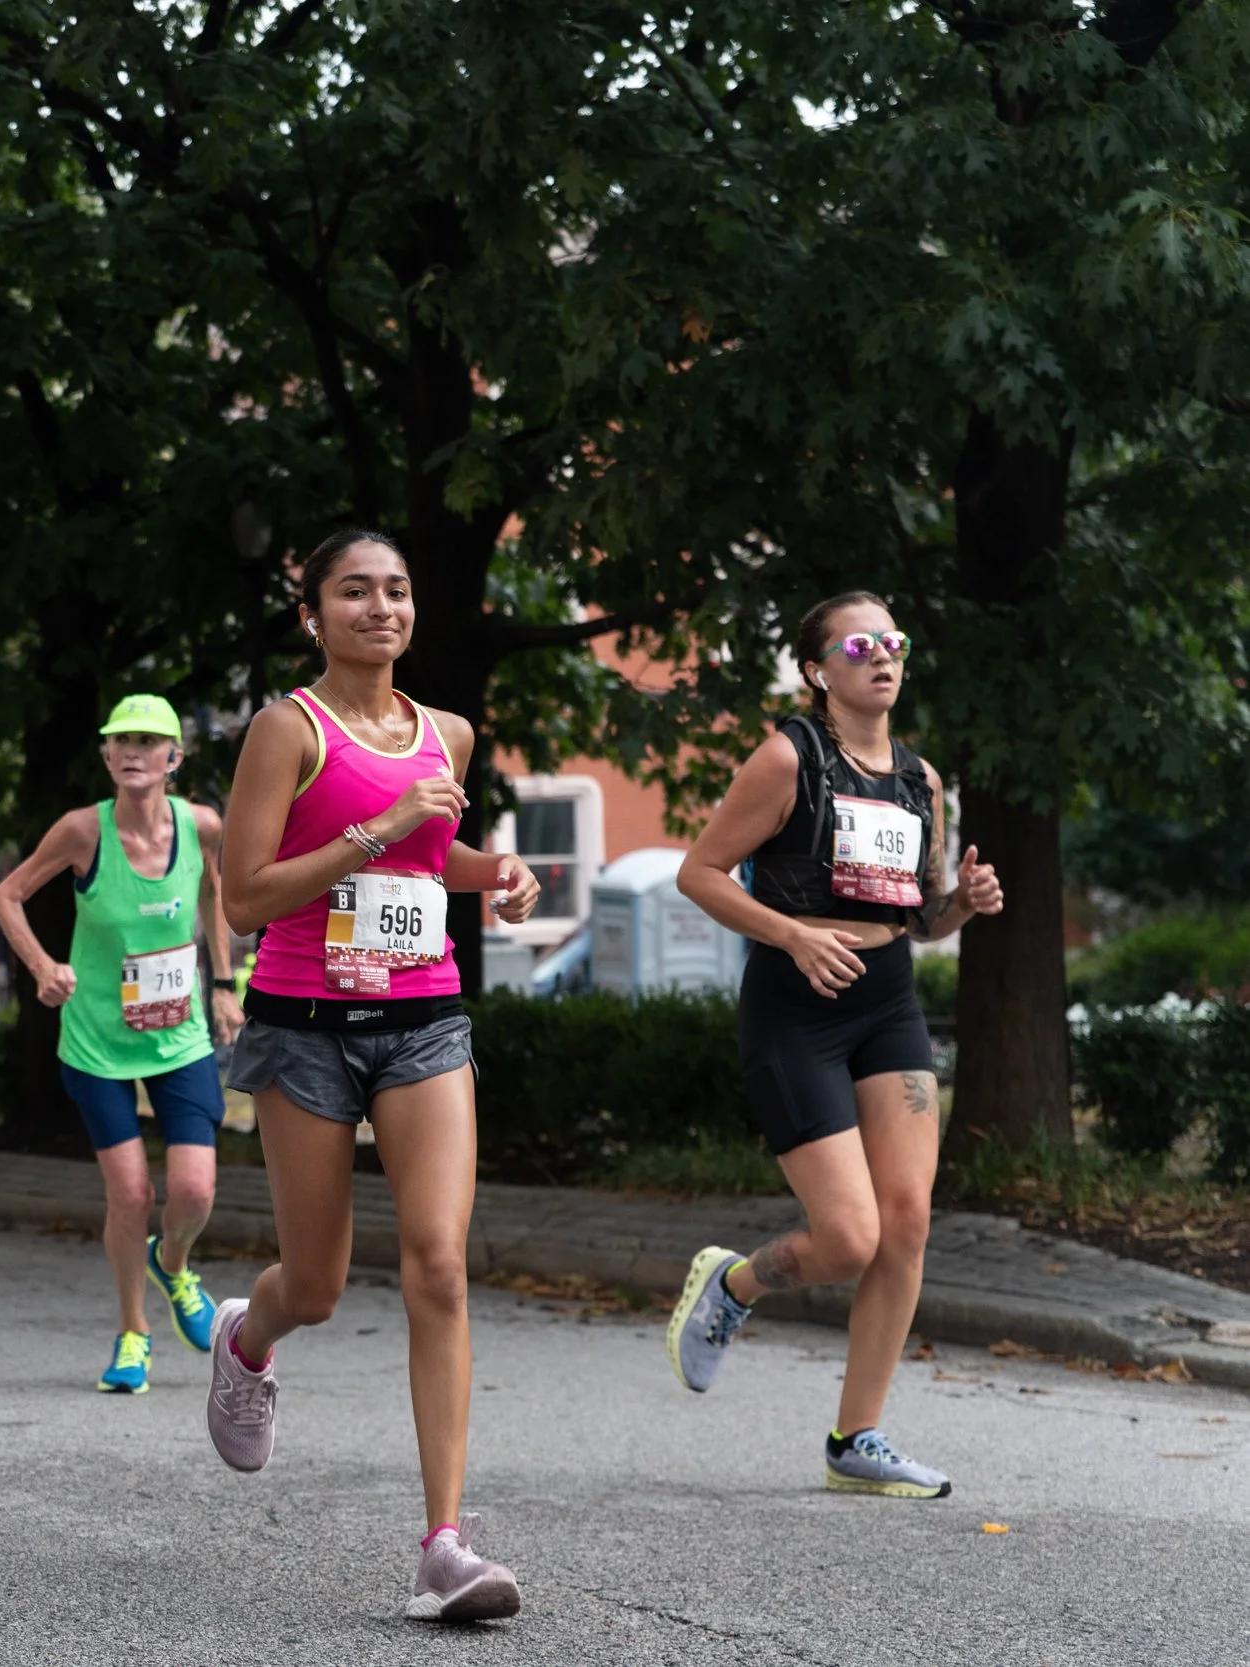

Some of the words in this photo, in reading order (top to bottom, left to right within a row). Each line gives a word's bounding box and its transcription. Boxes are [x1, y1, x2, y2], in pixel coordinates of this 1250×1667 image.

[875, 829, 904, 854] 436
[338, 892, 348, 909] B
[380, 904, 422, 936] 596
[387, 937, 414, 951] LAILA
[156, 969, 183, 992] 718
[339, 978, 355, 989] 596
